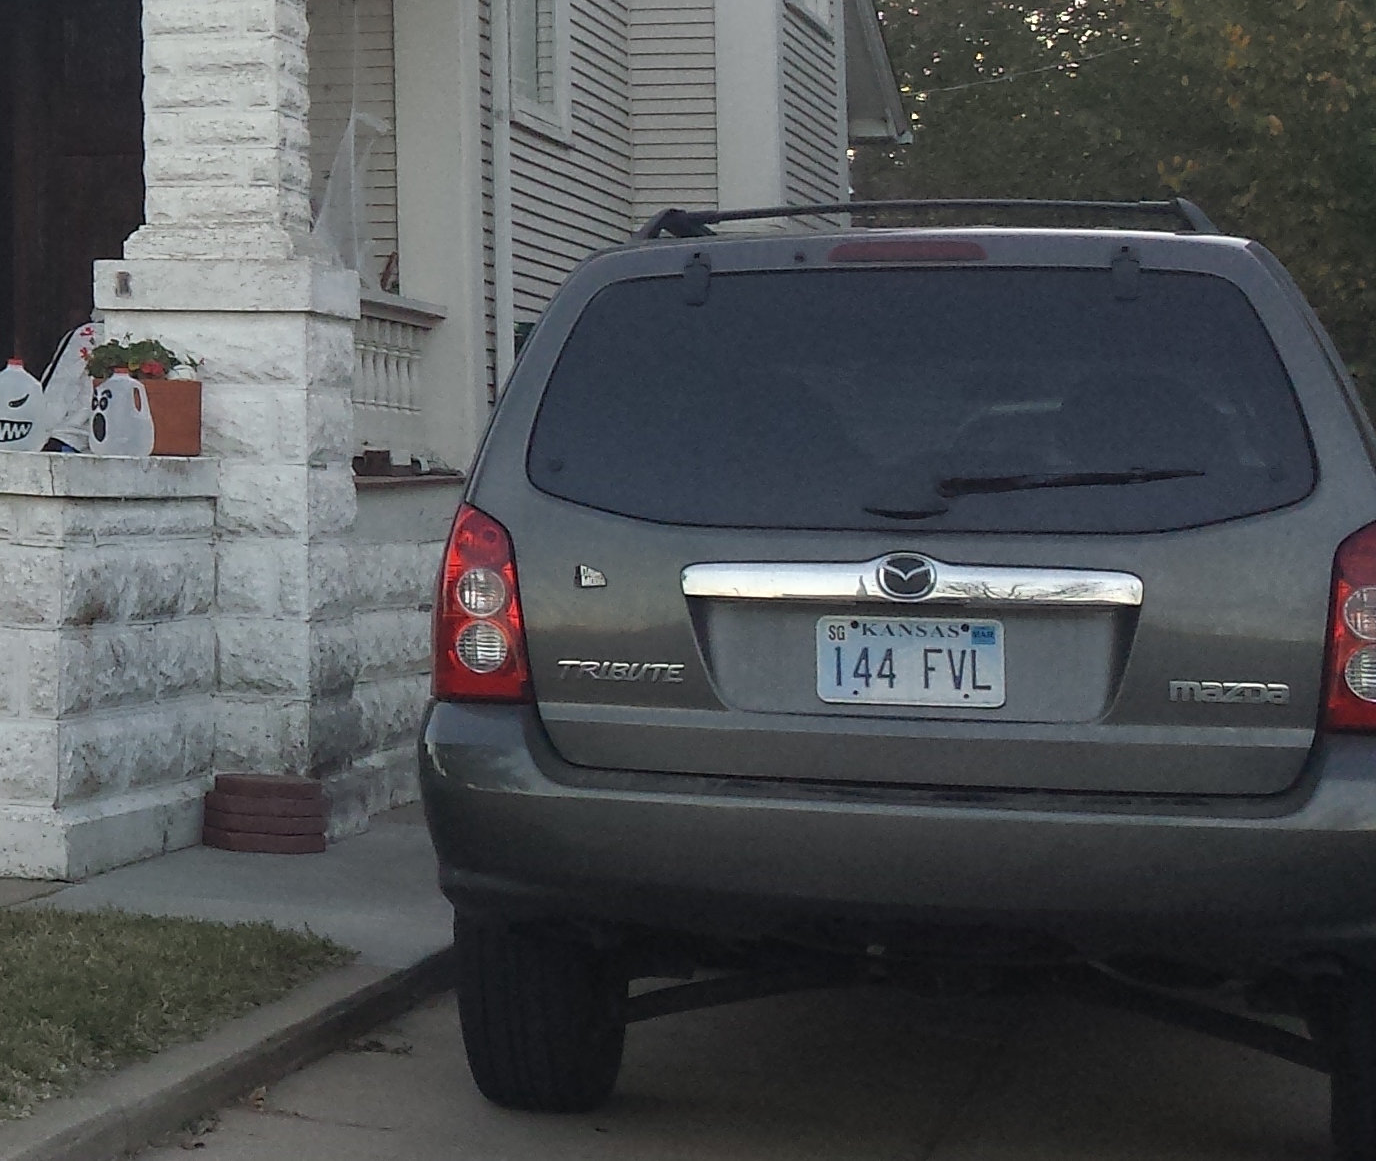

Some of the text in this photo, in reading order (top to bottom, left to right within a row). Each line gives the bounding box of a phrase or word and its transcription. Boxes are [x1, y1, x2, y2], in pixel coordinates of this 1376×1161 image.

[828, 622, 959, 641] SG KANSAS
[557, 660, 685, 682] TRIBUTE
[835, 646, 992, 691] 144 FVL
